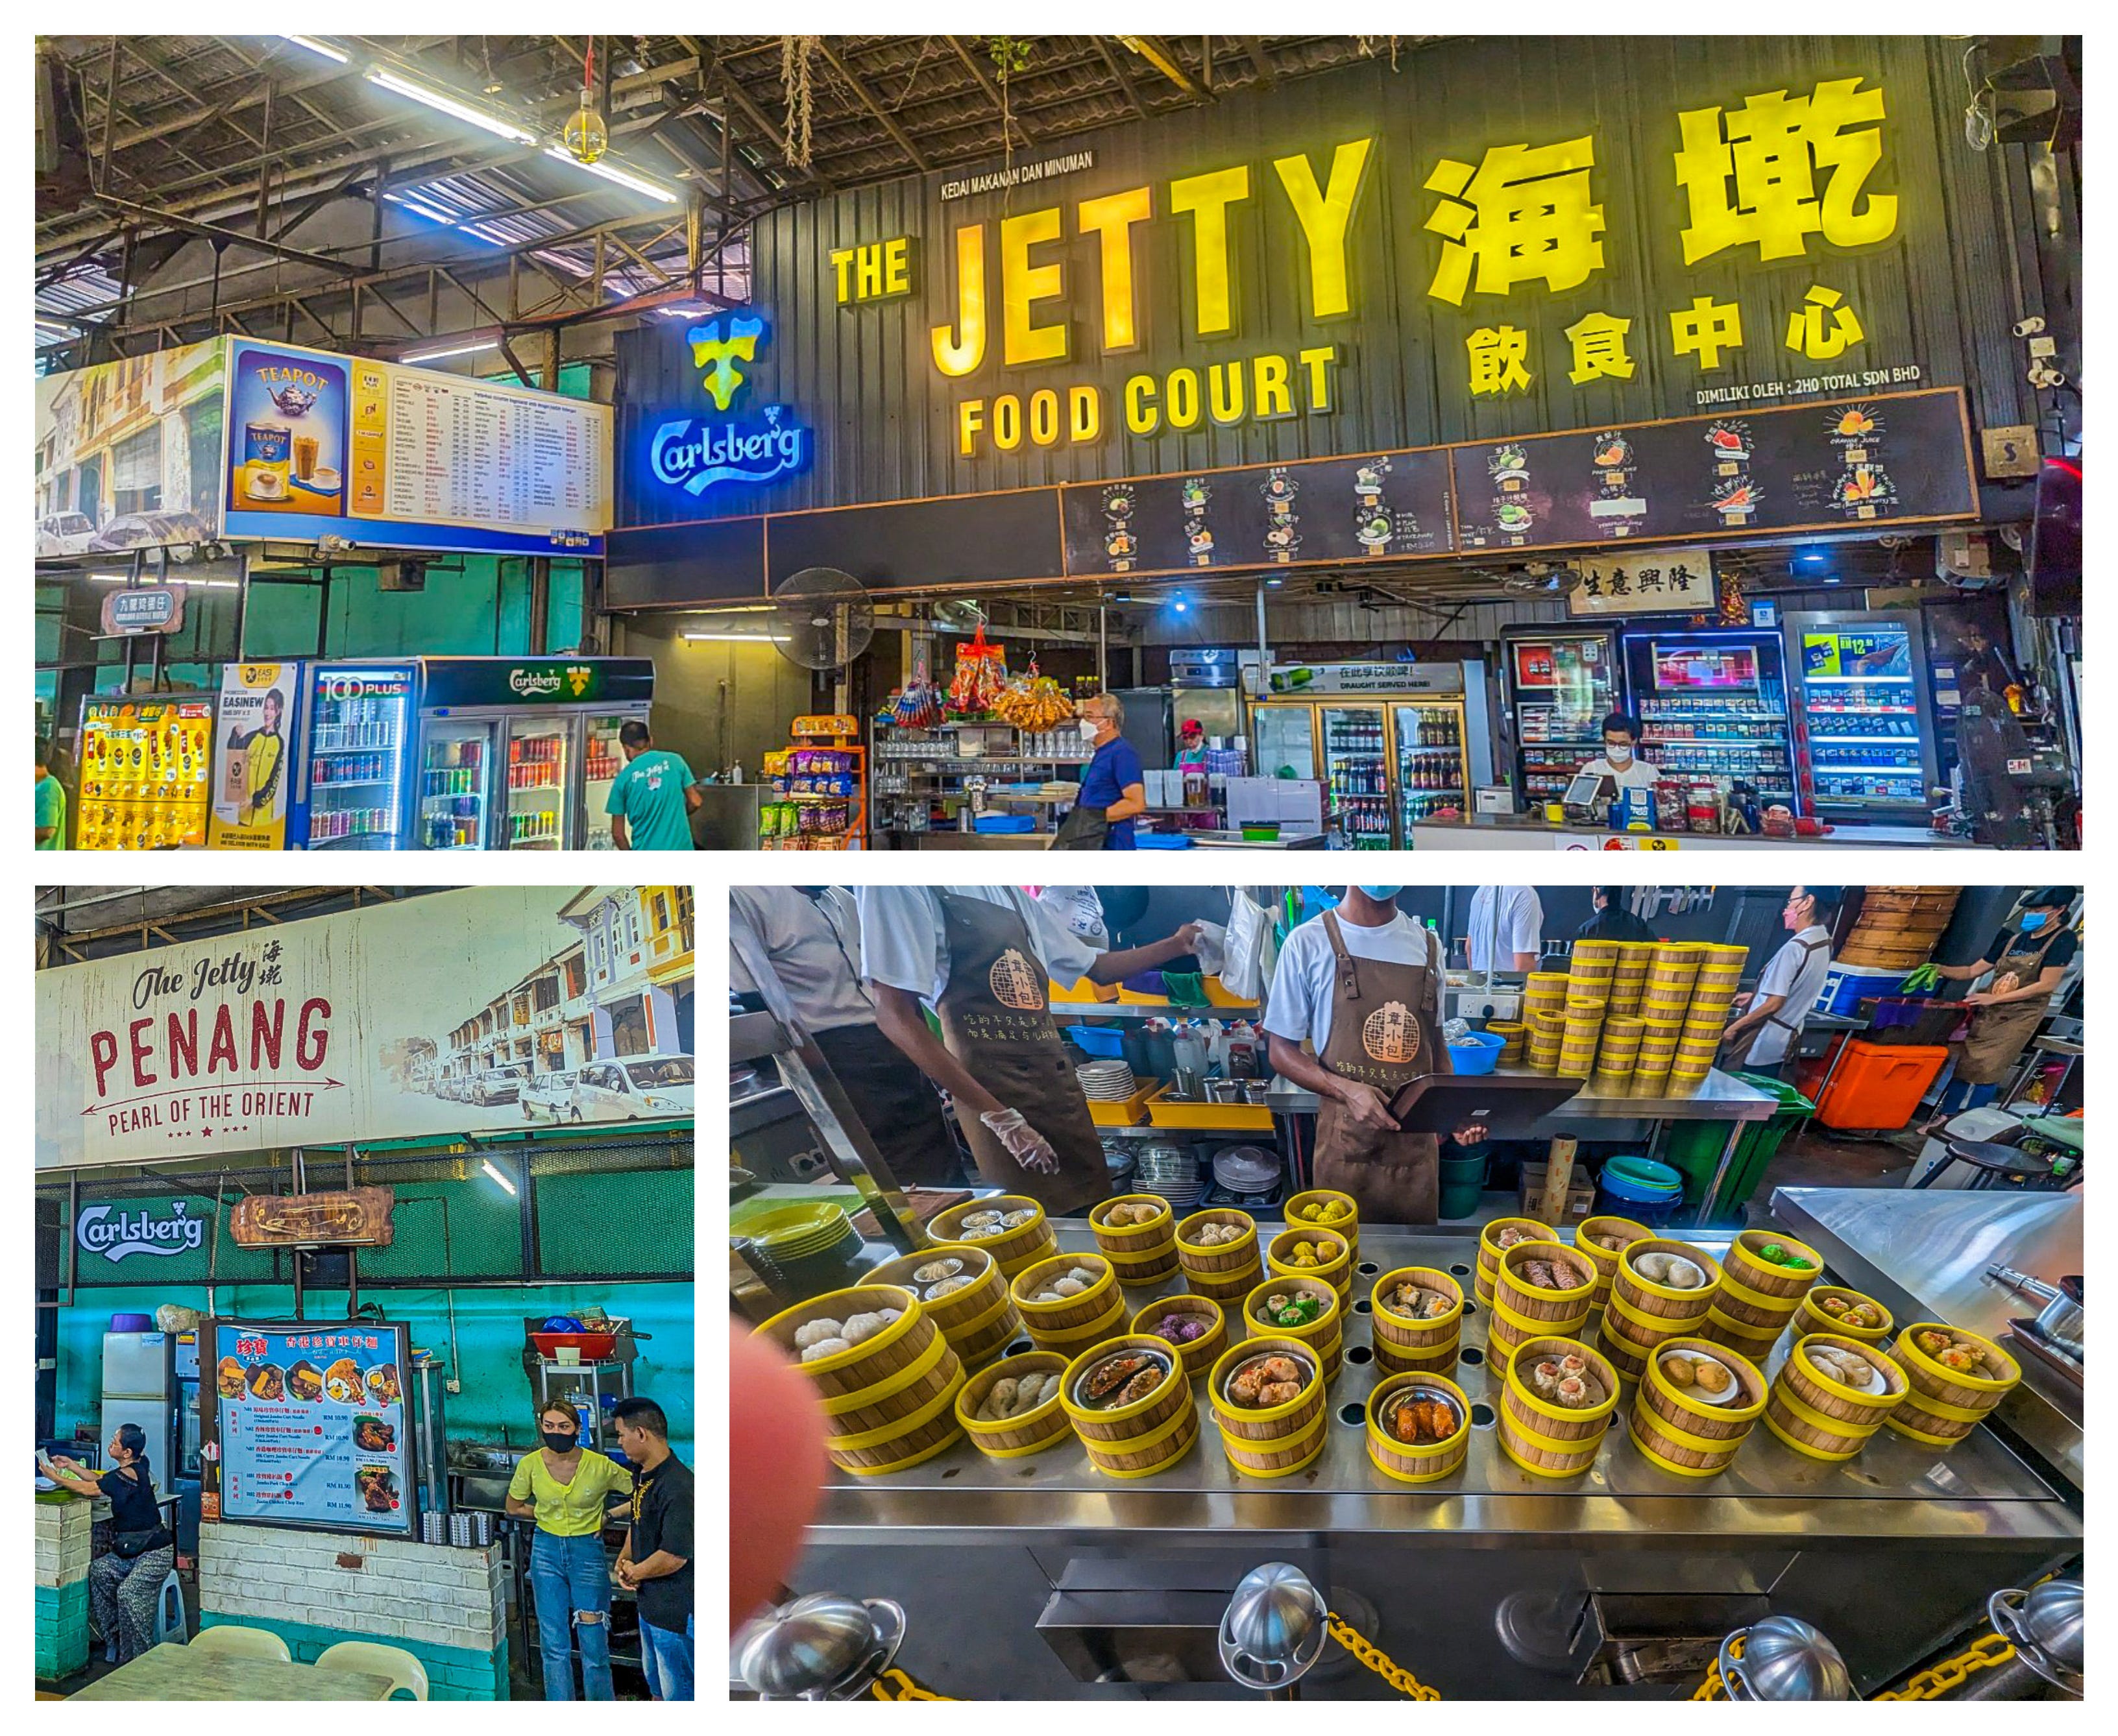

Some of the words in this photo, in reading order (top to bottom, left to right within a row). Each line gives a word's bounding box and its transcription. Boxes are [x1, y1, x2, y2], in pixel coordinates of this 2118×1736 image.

[942, 180, 969, 200] KEDAI
[971, 167, 1019, 193] MAKANAN
[1021, 163, 1042, 182] DAN
[1045, 151, 1092, 177] MINUMAN
[832, 237, 908, 303] THE
[932, 138, 1370, 376] JETTY
[1468, 284, 1864, 397] 飲食中心
[256, 367, 328, 391] TEAPOT
[960, 385, 1099, 454] FOOD
[1125, 347, 1333, 434] COURT
[1696, 385, 1749, 404] DIMILIKI
[1753, 381, 1783, 398] OLEH
[1821, 374, 1860, 390] TOTAL
[1863, 370, 1890, 385] SDN
[1893, 365, 1920, 381] BHD
[251, 433, 286, 443] TEAPOT
[651, 419, 801, 496] Carlsberg
[1584, 564, 1698, 597] 生意興隆
[324, 676, 363, 701] 100
[366, 683, 402, 694] PLUS
[509, 669, 561, 696] Carlsberg
[133, 966, 184, 1010] The
[190, 952, 256, 1000] Jetty
[90, 997, 332, 1097] PENANG
[108, 1103, 162, 1136] PEARL
[170, 1098, 192, 1123] OF
[199, 1094, 233, 1118] THE
[241, 1092, 314, 1117] ORIENT
[77, 1206, 202, 1262] Carlsberg
